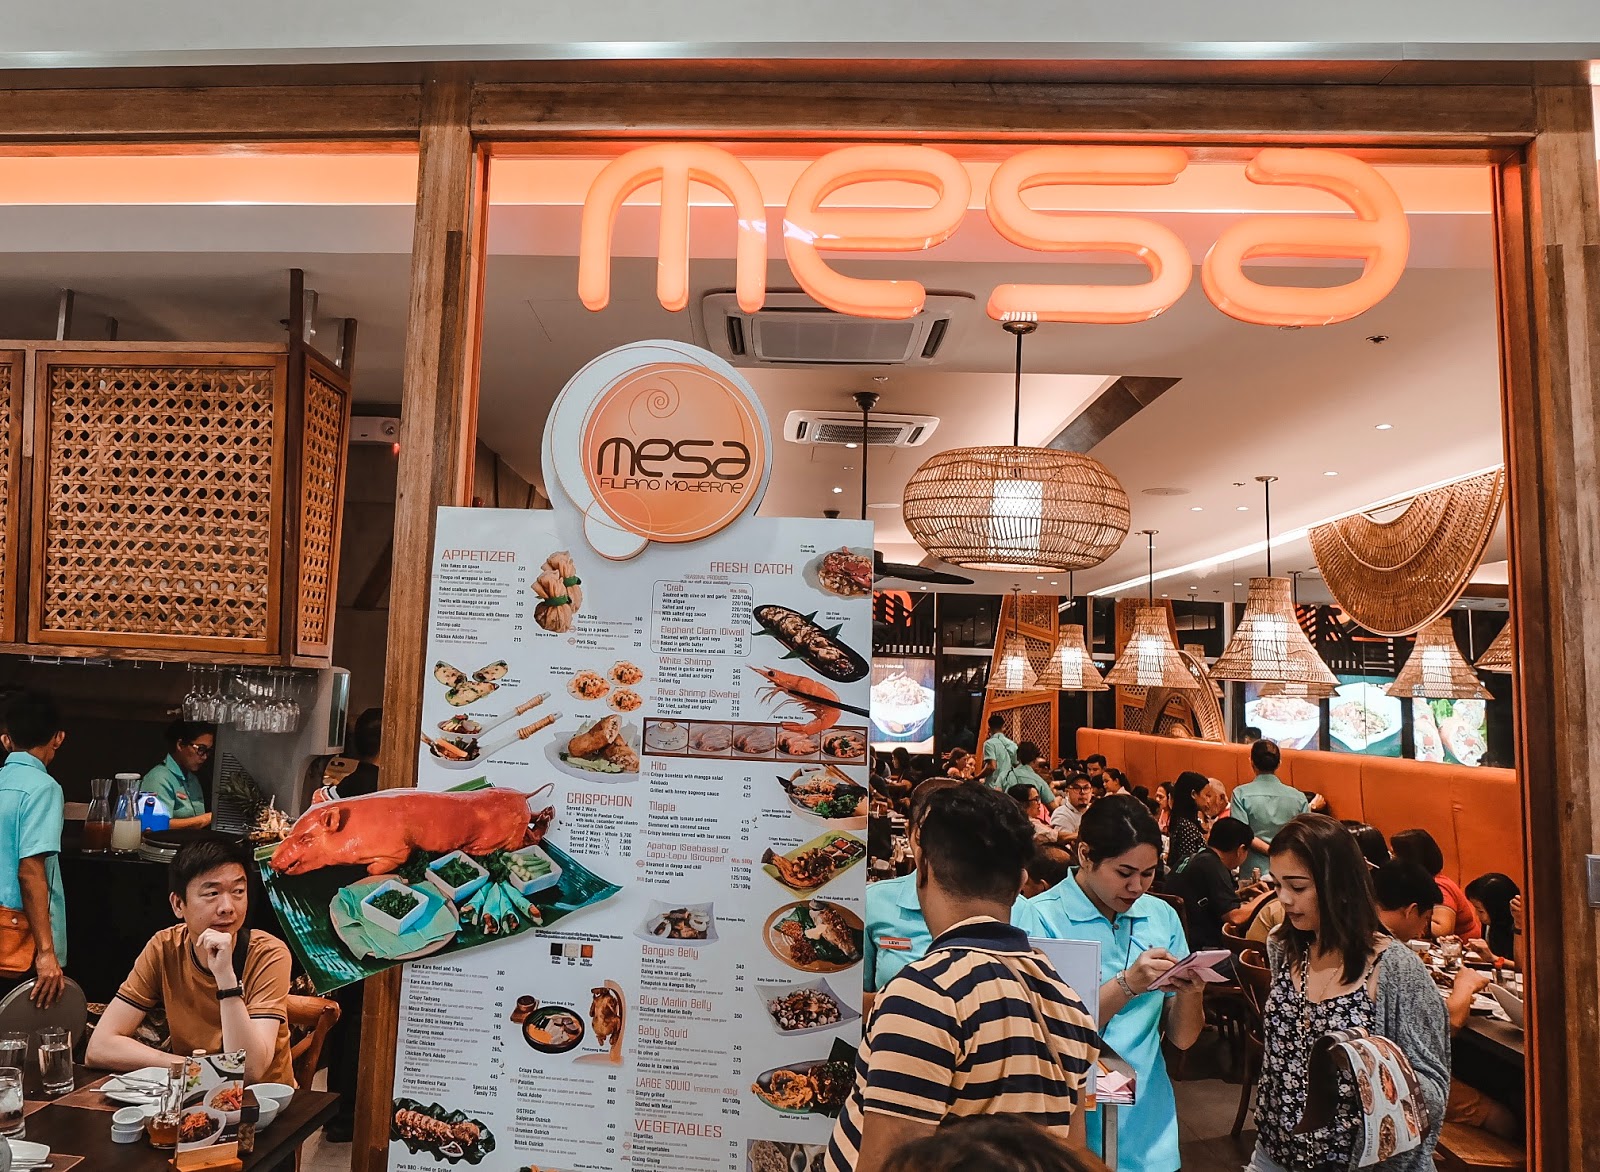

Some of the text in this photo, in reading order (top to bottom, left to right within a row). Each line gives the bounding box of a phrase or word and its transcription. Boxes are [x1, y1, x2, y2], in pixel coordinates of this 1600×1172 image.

[577, 142, 1410, 327] mesa
[597, 437, 751, 480] mesa
[442, 550, 515, 562] APPETIZER
[710, 562, 793, 574] FRESH CATCH
[661, 626, 694, 635] Elephant
[683, 658, 712, 667] Shrimp
[678, 689, 706, 698] Shrimp
[651, 761, 667, 770] Hito
[567, 793, 632, 807] CRISPCHON
[649, 801, 676, 814] Tilapia
[647, 851, 688, 862] Lapu-Lapu
[642, 945, 699, 960] Bangus Belly
[640, 995, 712, 1012] Blue Marlin Belly
[638, 1025, 688, 1040] Baby Squid
[636, 1078, 690, 1091] LARGE SQUID
[635, 1119, 722, 1138] VEGETABLES
